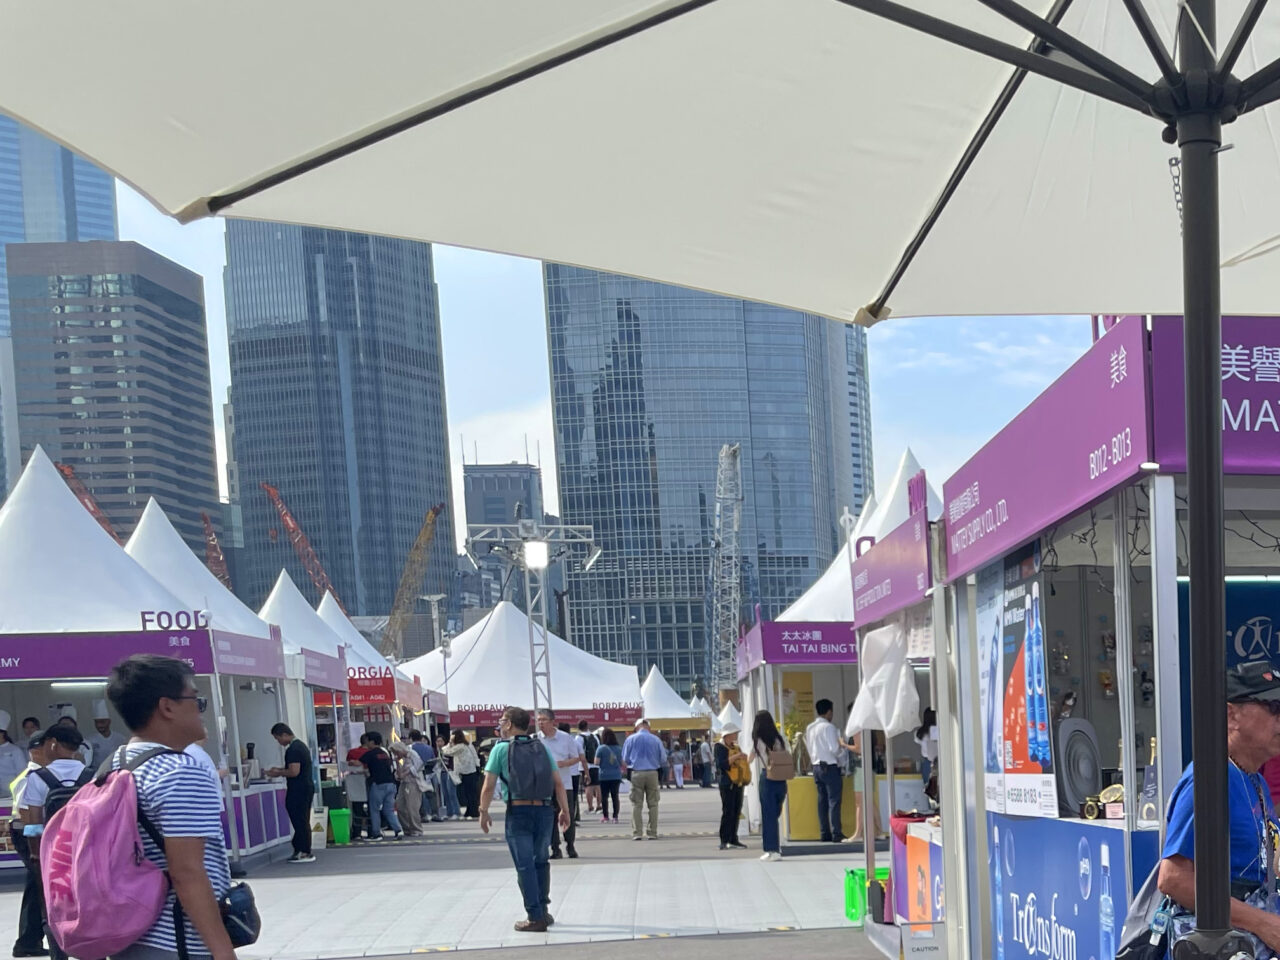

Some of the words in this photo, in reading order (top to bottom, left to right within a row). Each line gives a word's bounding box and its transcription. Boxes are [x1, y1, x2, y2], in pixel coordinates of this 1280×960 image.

[1110, 345, 1128, 389] 美食
[141, 610, 209, 631] FOOD
[168, 636, 190, 647] 美食
[782, 643, 799, 653] TAI
[801, 643, 818, 653] TAI
[821, 643, 848, 654] BING
[0, 657, 20, 668] MY
[347, 665, 394, 679] ORGIA
[457, 703, 509, 712] BORDEAUX
[592, 701, 642, 710] BORDEAUX
